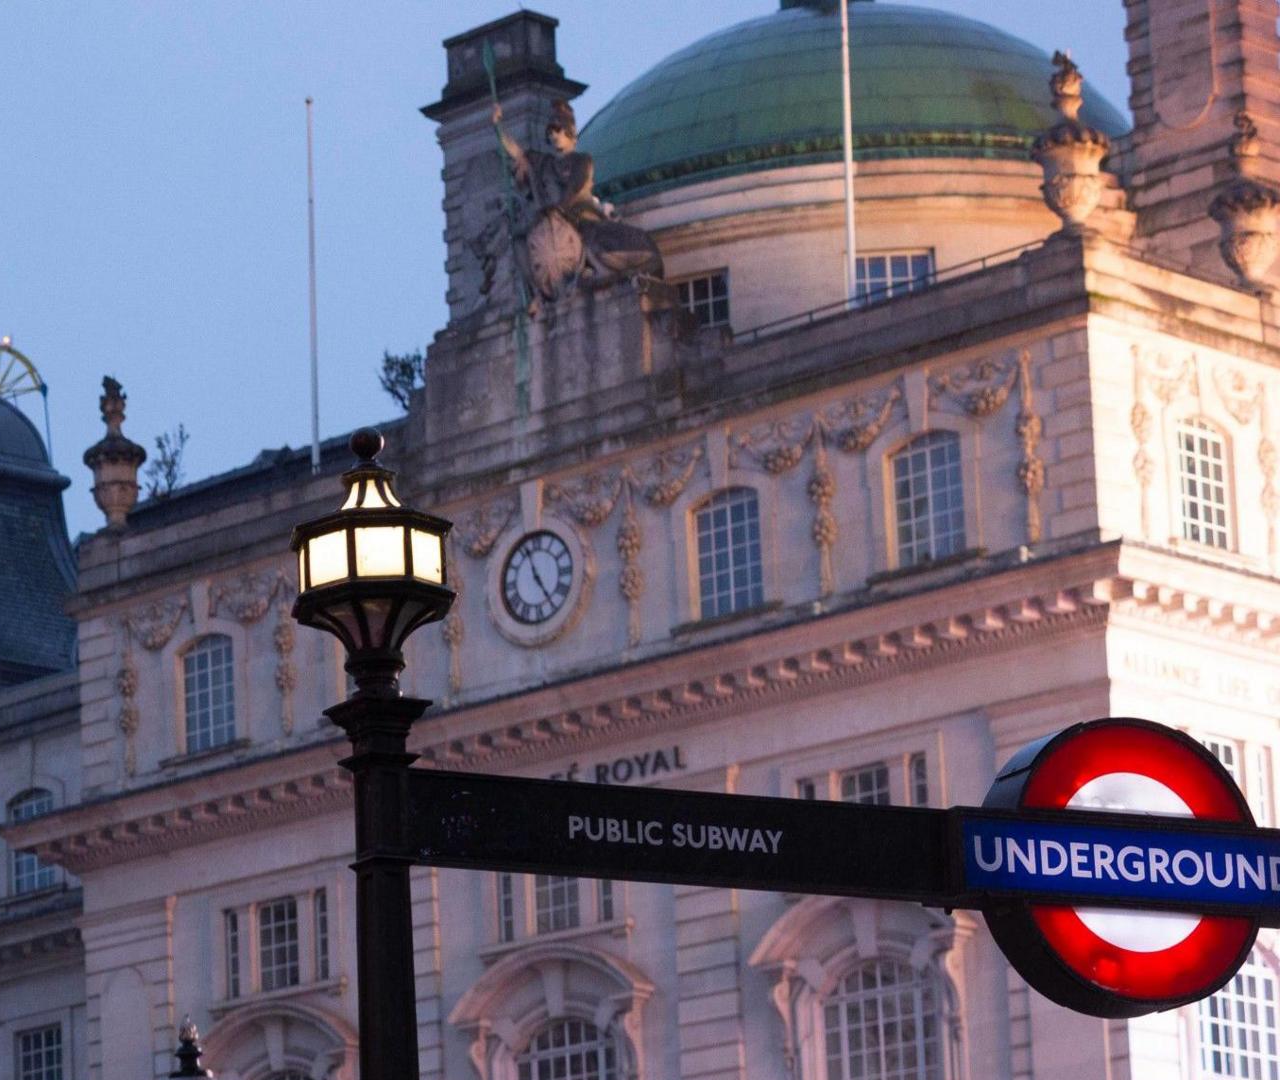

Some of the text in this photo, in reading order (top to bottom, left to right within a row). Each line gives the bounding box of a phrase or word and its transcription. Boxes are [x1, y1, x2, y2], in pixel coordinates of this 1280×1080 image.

[595, 746, 687, 784] ROYAL
[569, 815, 784, 855] PUBLIC SUBWAY
